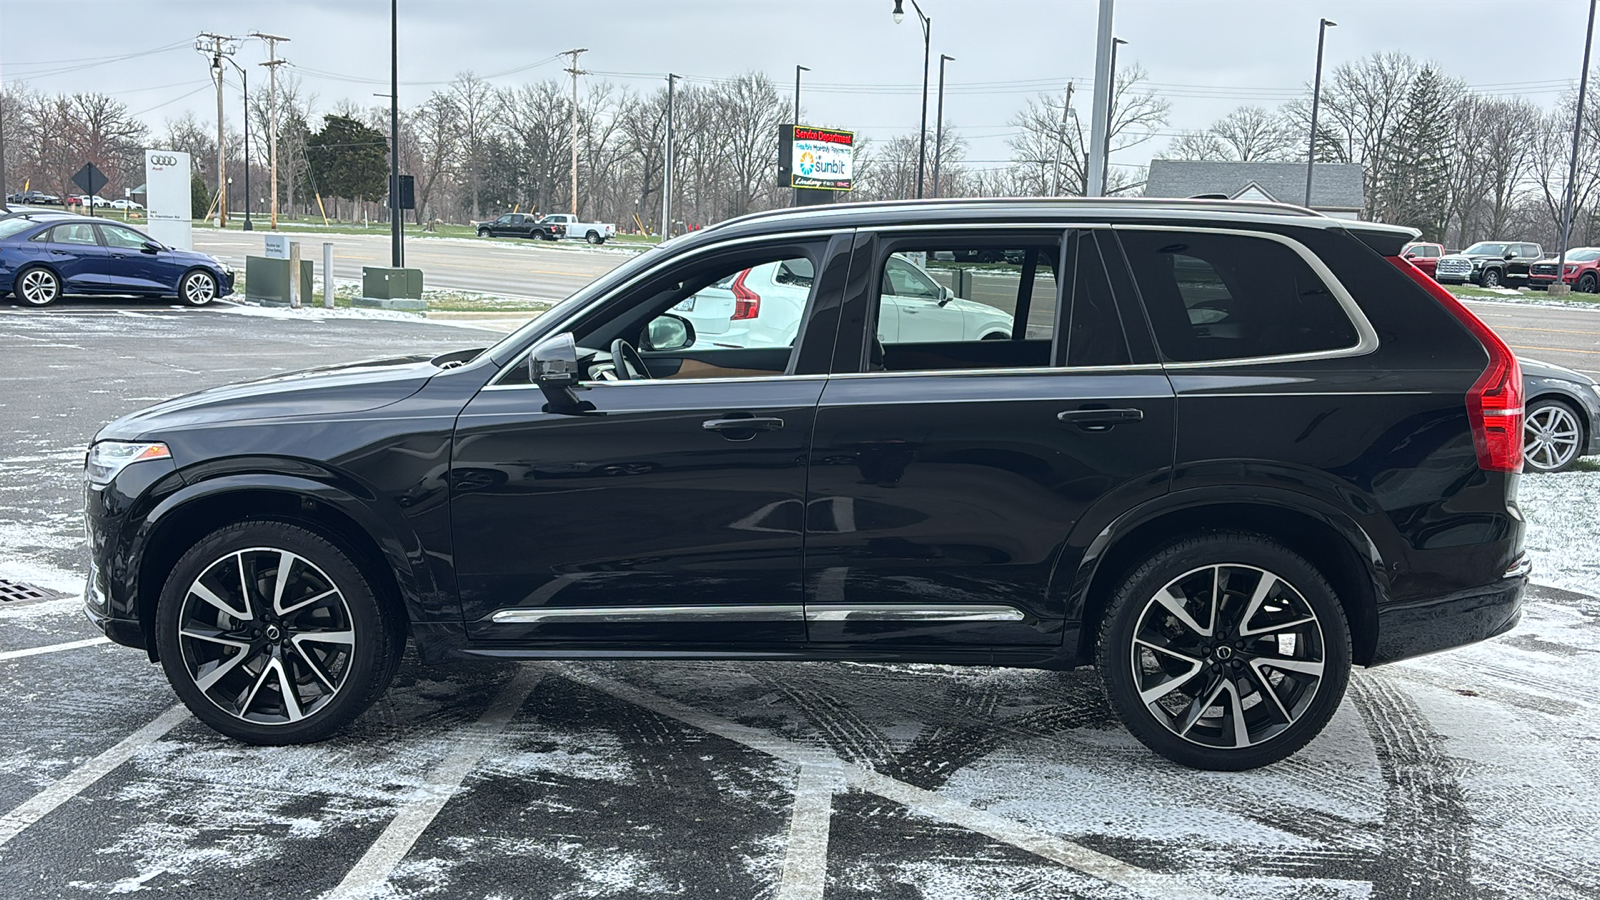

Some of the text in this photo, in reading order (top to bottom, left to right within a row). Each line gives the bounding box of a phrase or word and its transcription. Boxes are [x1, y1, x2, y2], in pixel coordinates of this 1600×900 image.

[796, 128, 851, 143] Service Department
[815, 159, 846, 175] sunbit
